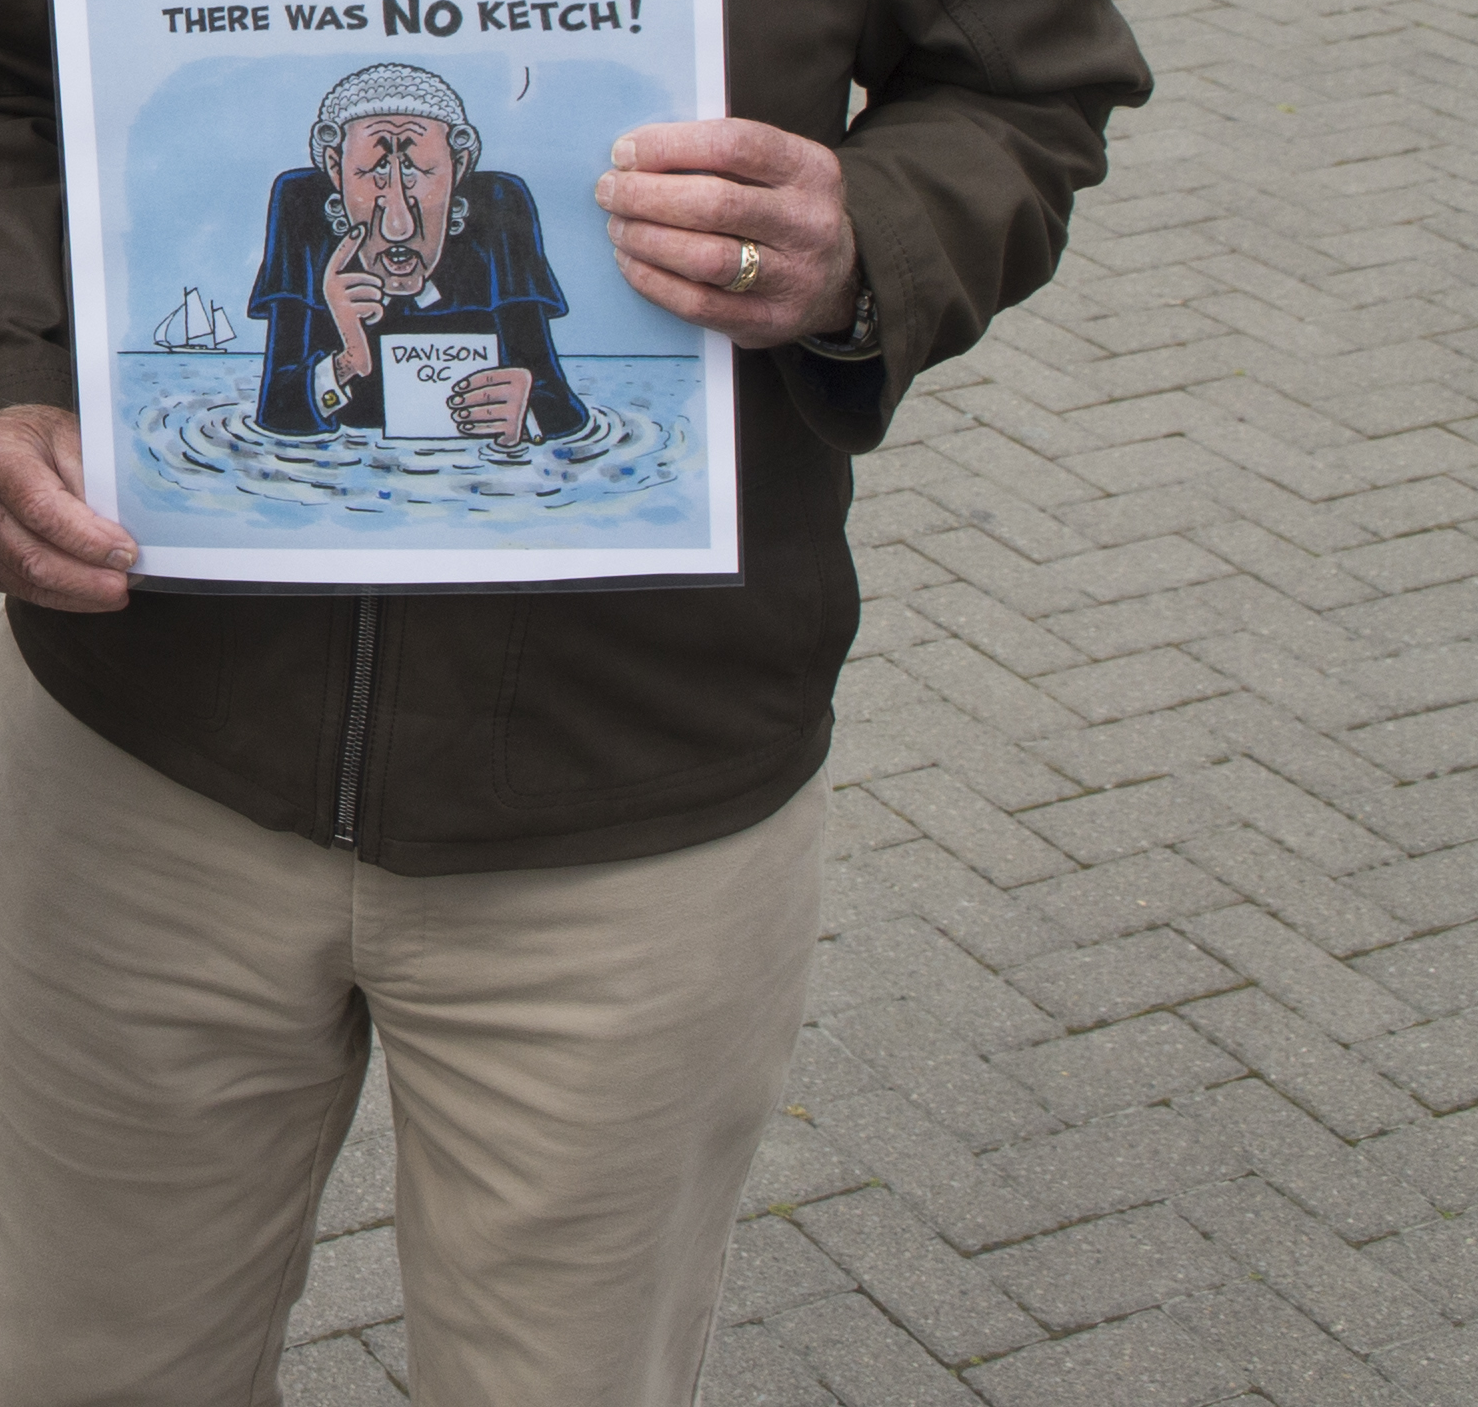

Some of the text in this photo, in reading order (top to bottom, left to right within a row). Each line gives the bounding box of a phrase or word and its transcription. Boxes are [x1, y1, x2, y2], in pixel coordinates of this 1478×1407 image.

[161, 4, 271, 34] THERE
[283, 3, 369, 31] WAS
[390, 343, 489, 365] DAVISON
[416, 363, 452, 384] QC
